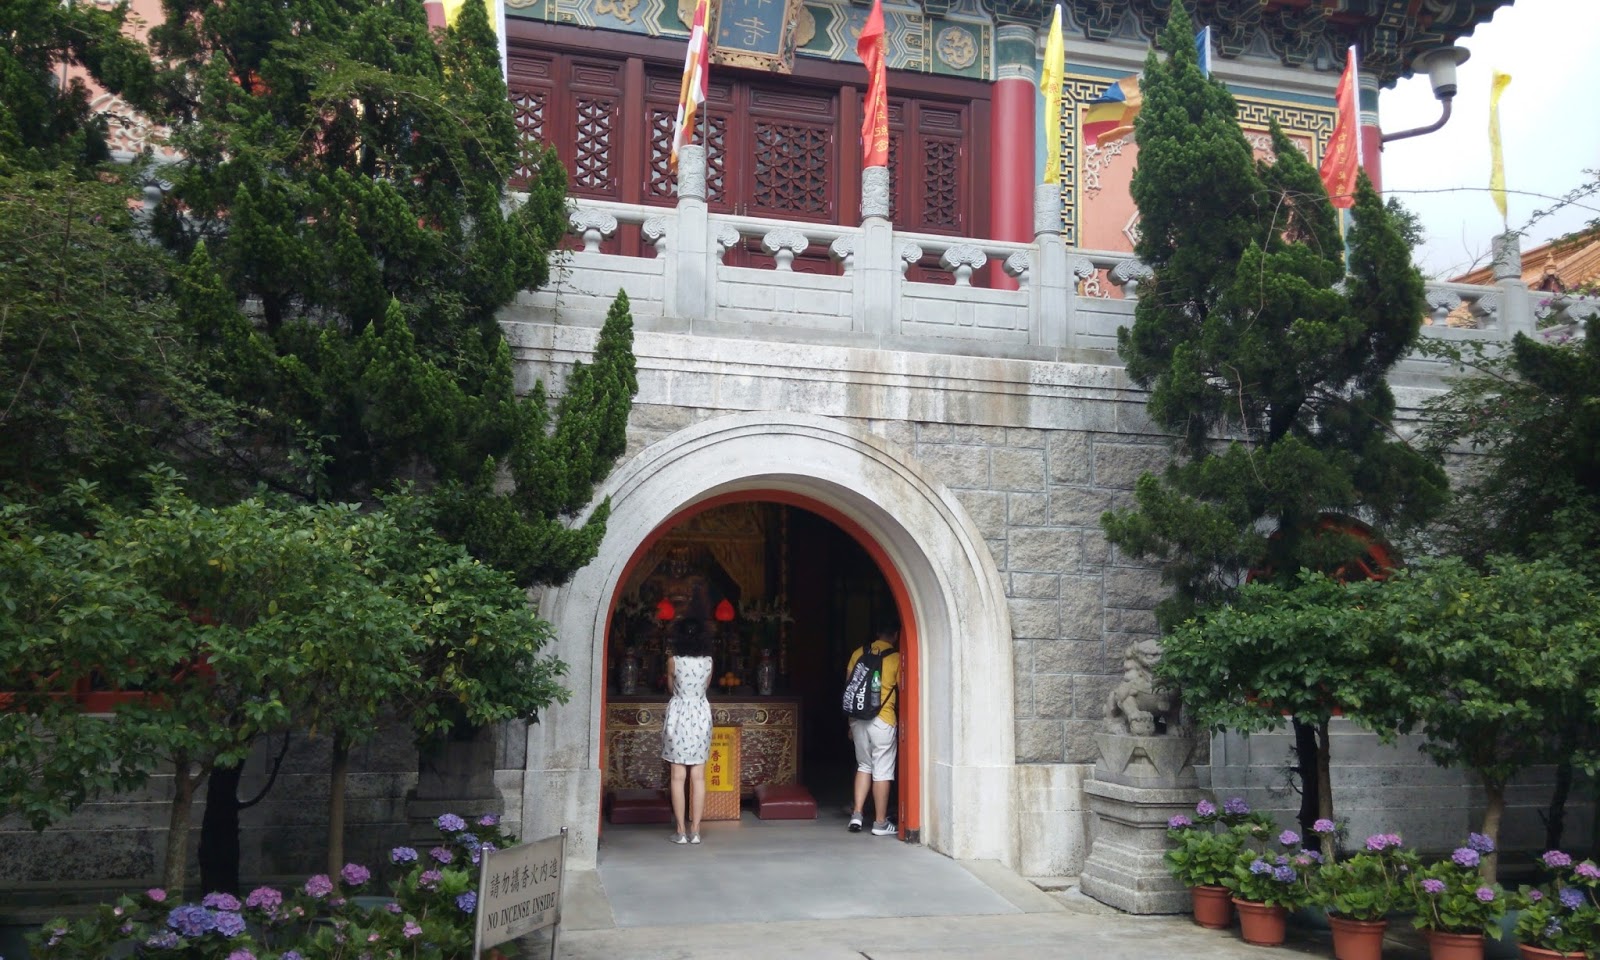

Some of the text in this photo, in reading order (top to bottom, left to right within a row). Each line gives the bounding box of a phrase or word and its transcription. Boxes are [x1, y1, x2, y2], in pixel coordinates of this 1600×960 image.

[734, 0, 771, 46] 寺
[487, 892, 556, 931] NO INCENSE INSIDE
